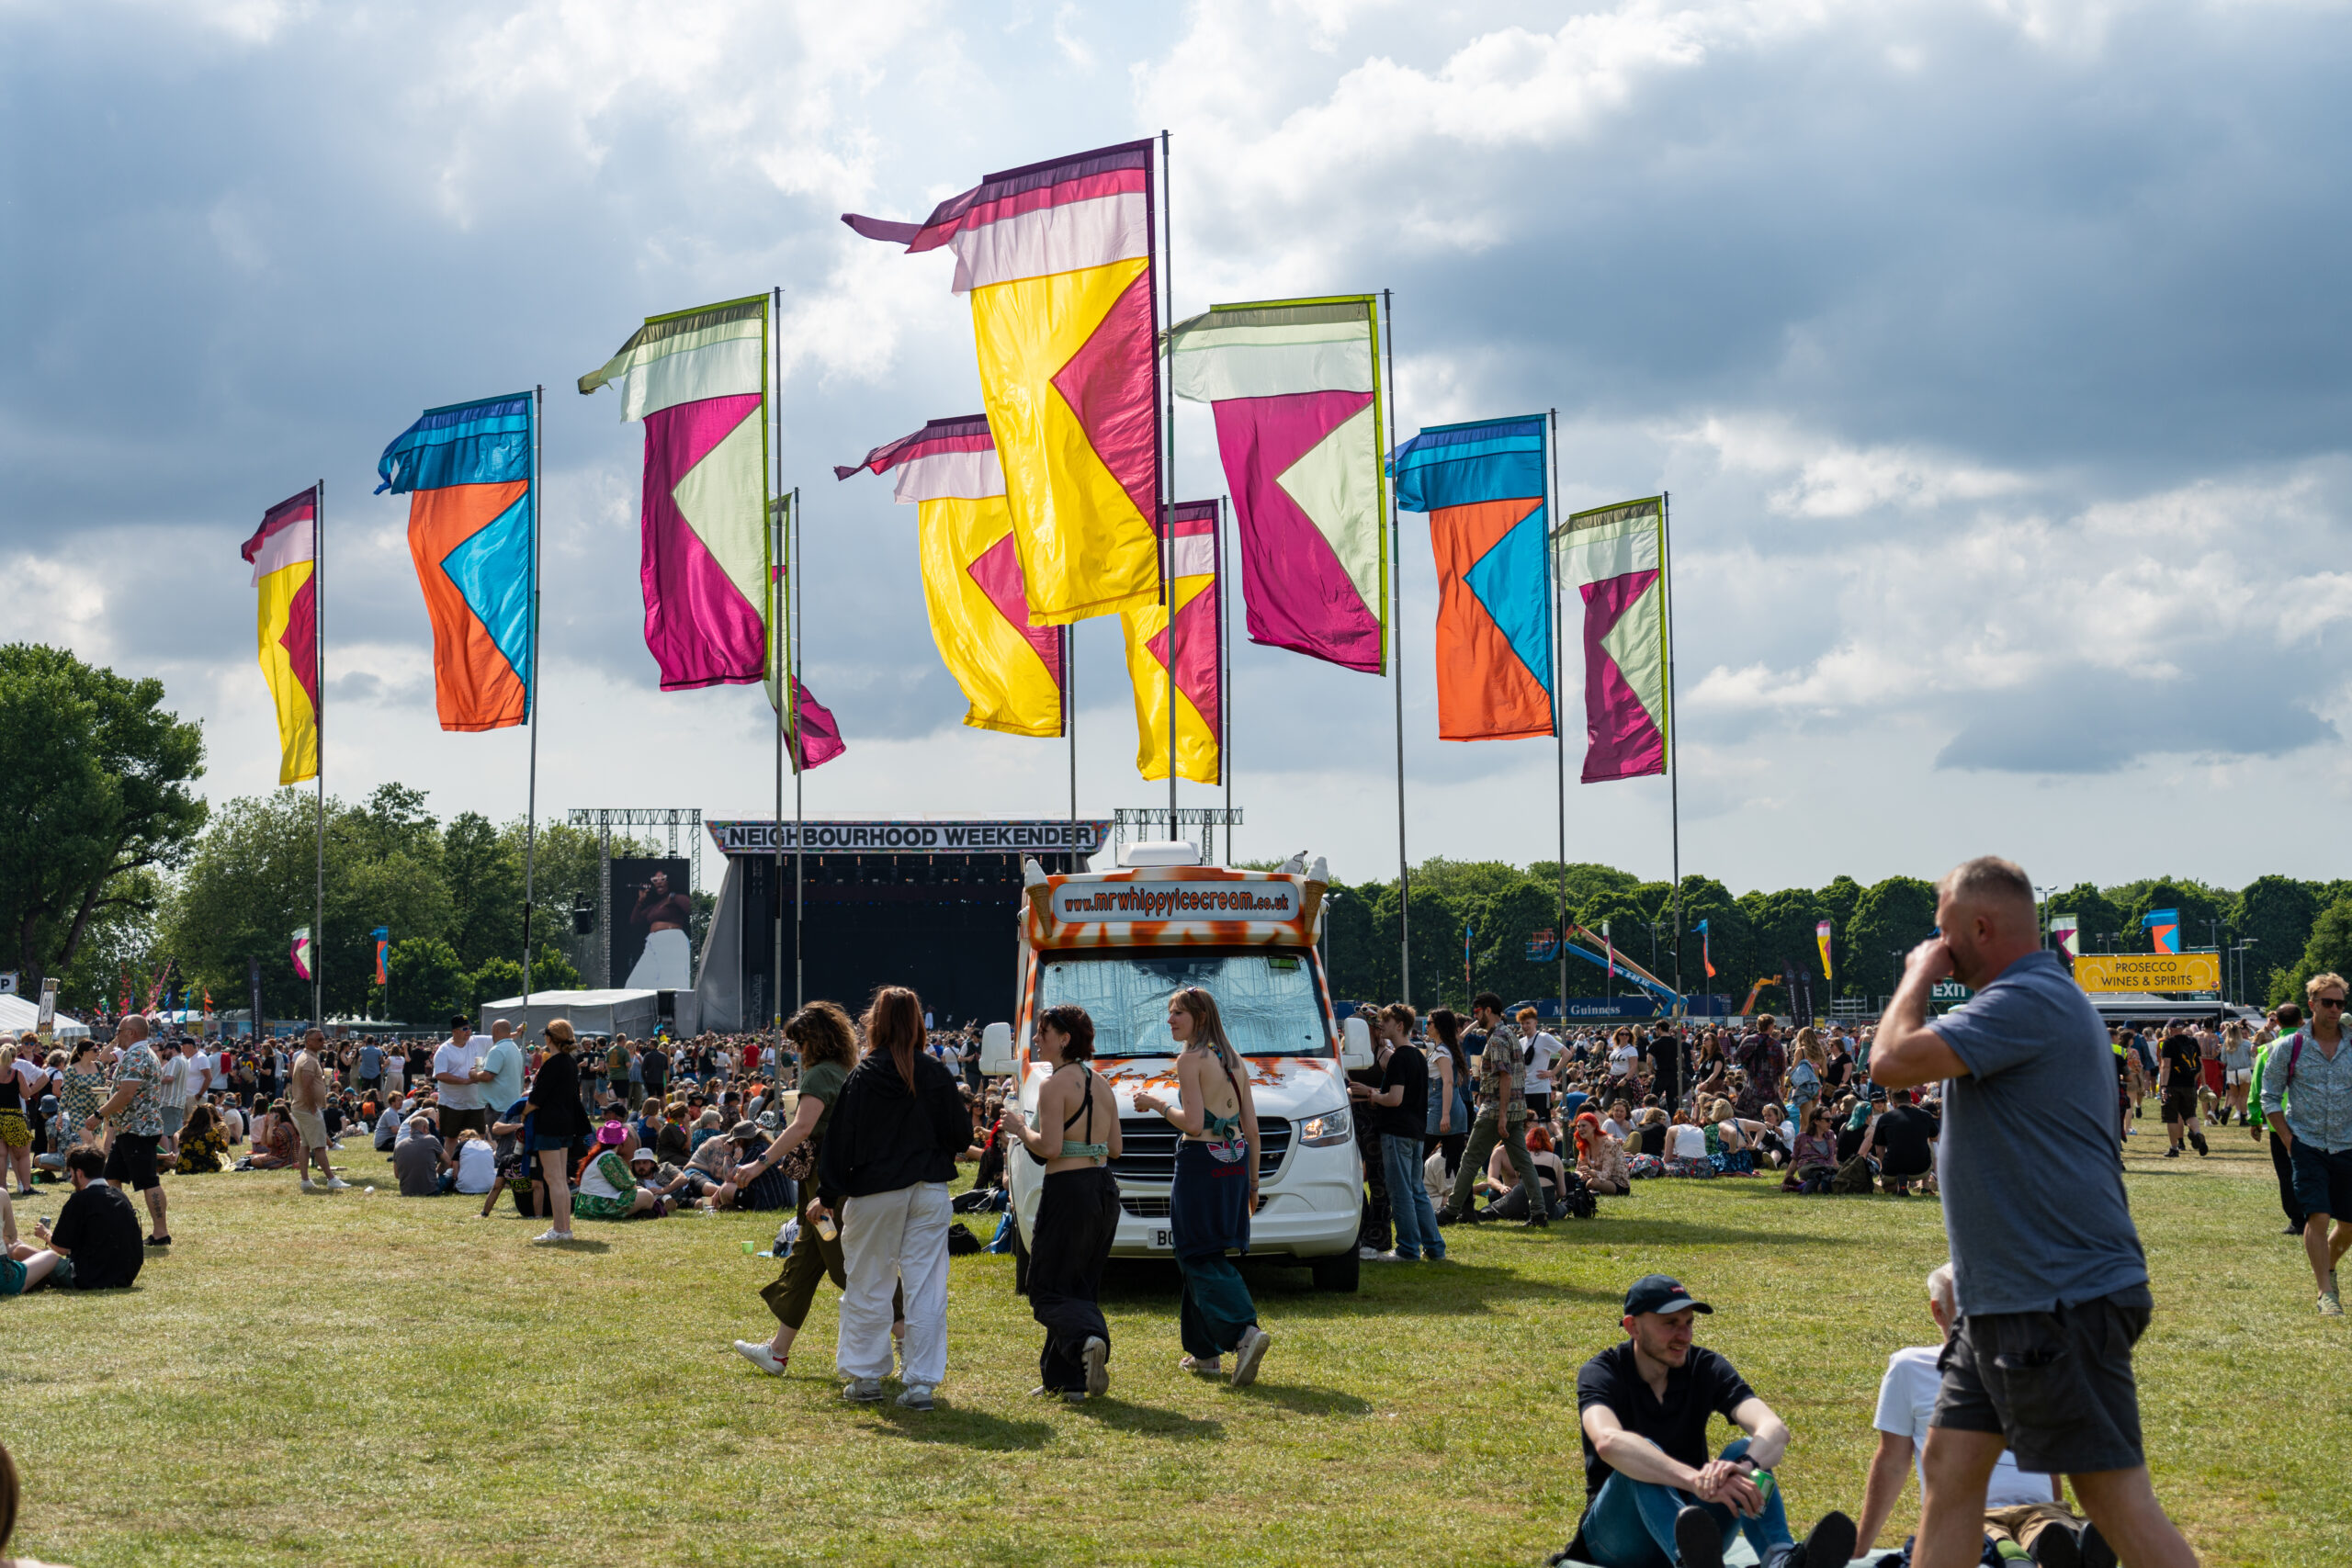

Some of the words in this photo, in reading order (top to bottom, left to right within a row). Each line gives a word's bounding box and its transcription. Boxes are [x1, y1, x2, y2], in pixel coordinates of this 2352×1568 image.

[729, 828, 938, 846] NEIGHBOURHOOD
[944, 827, 1091, 846] WEEKENDER
[1064, 886, 1289, 917] www.mrwhippyicecream.co.uk
[2115, 962, 2177, 973] PROSECCO
[2101, 976, 2139, 987] WINES
[2142, 976, 2151, 986] &
[2154, 976, 2193, 986] SPIRITS
[1932, 983, 1966, 997] EXIT
